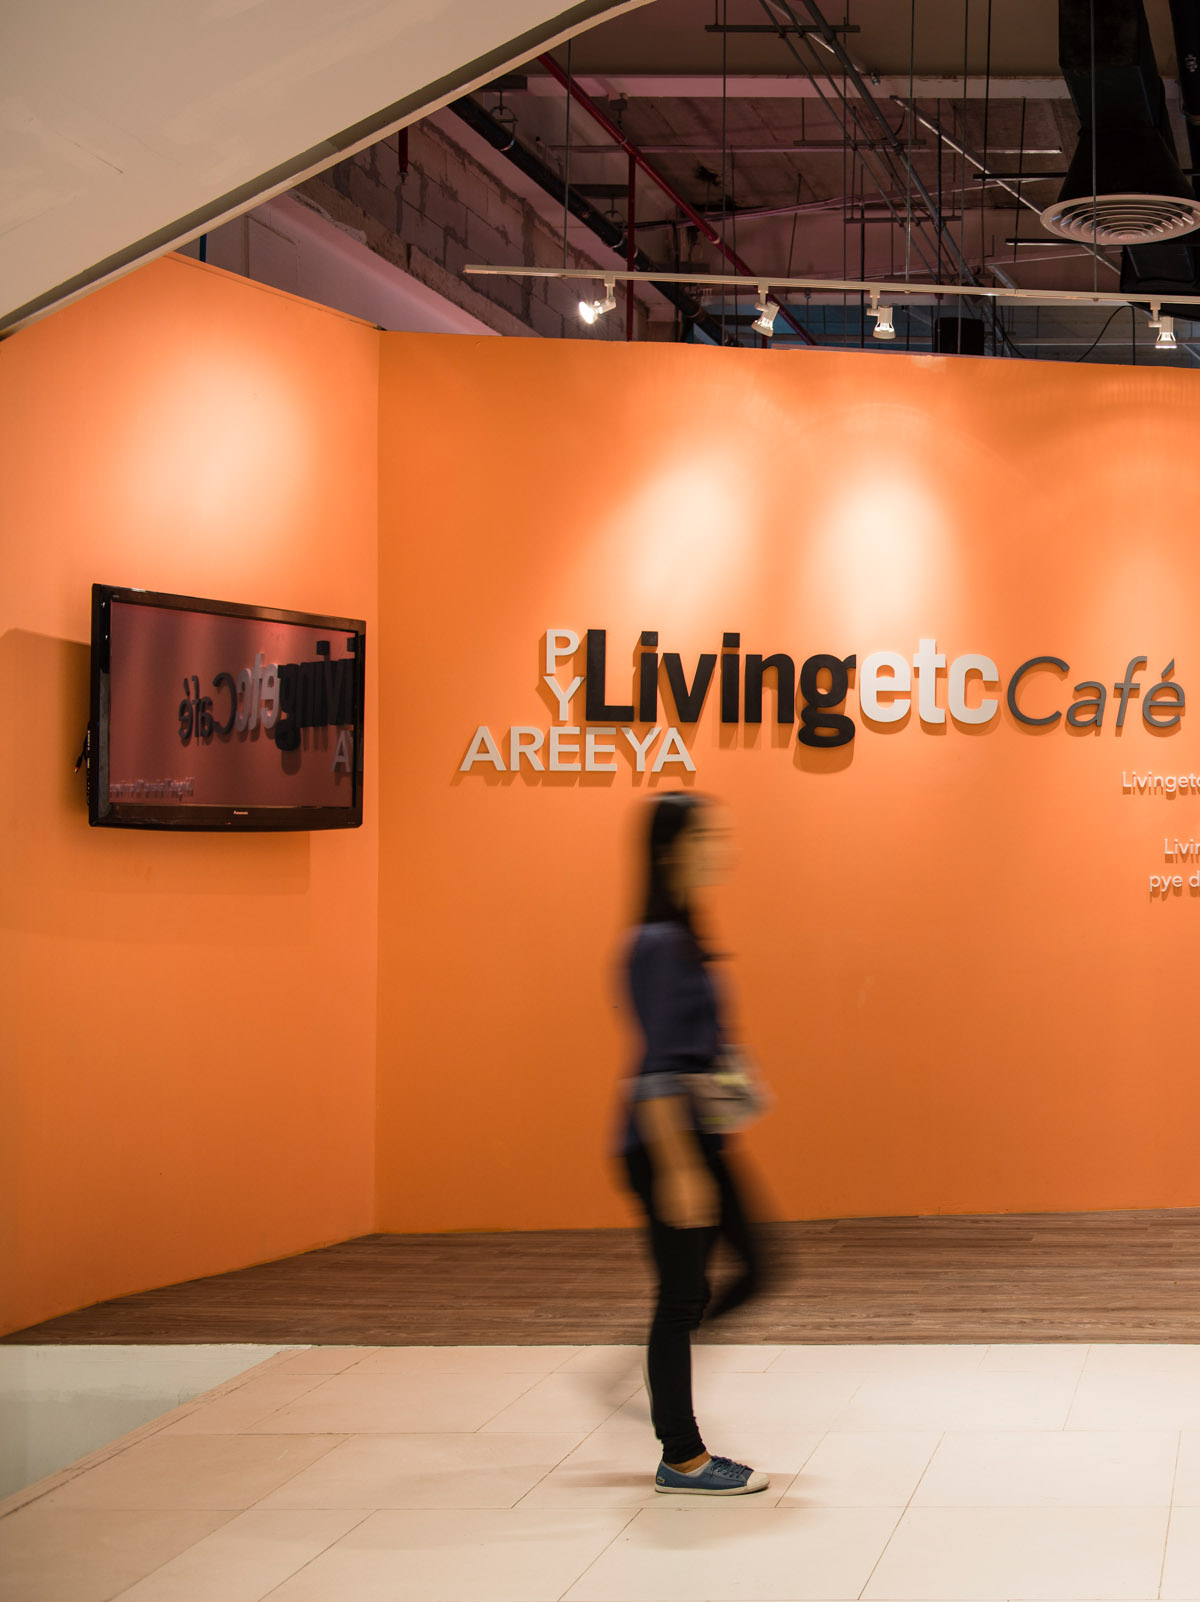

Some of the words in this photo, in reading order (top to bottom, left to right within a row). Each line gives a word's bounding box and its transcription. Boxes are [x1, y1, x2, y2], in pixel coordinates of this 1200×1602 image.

[1007, 654, 1186, 728] Café
[459, 726, 697, 772] AREEYA
[1149, 875, 1183, 892] pye
